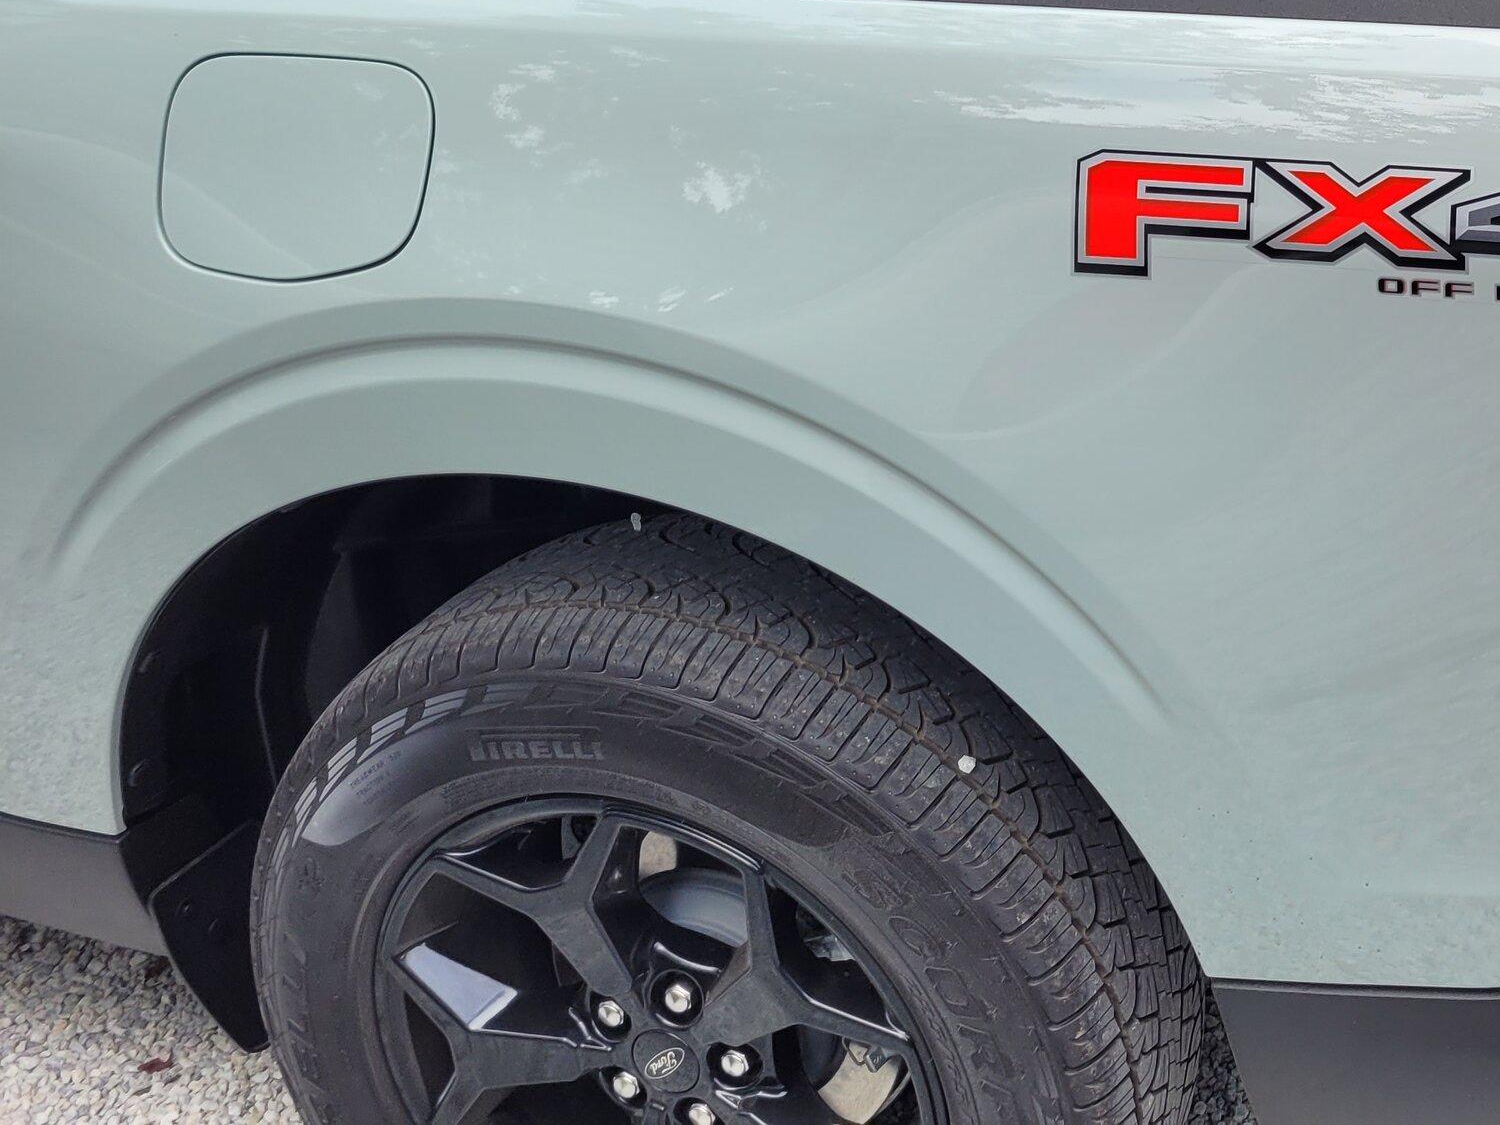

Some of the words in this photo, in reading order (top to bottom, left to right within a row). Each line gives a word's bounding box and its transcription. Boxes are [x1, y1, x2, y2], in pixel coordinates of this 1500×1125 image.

[1378, 278, 1474, 298] OFF
[467, 727, 604, 762] PIRELLI
[648, 1050, 678, 1076] Ford
